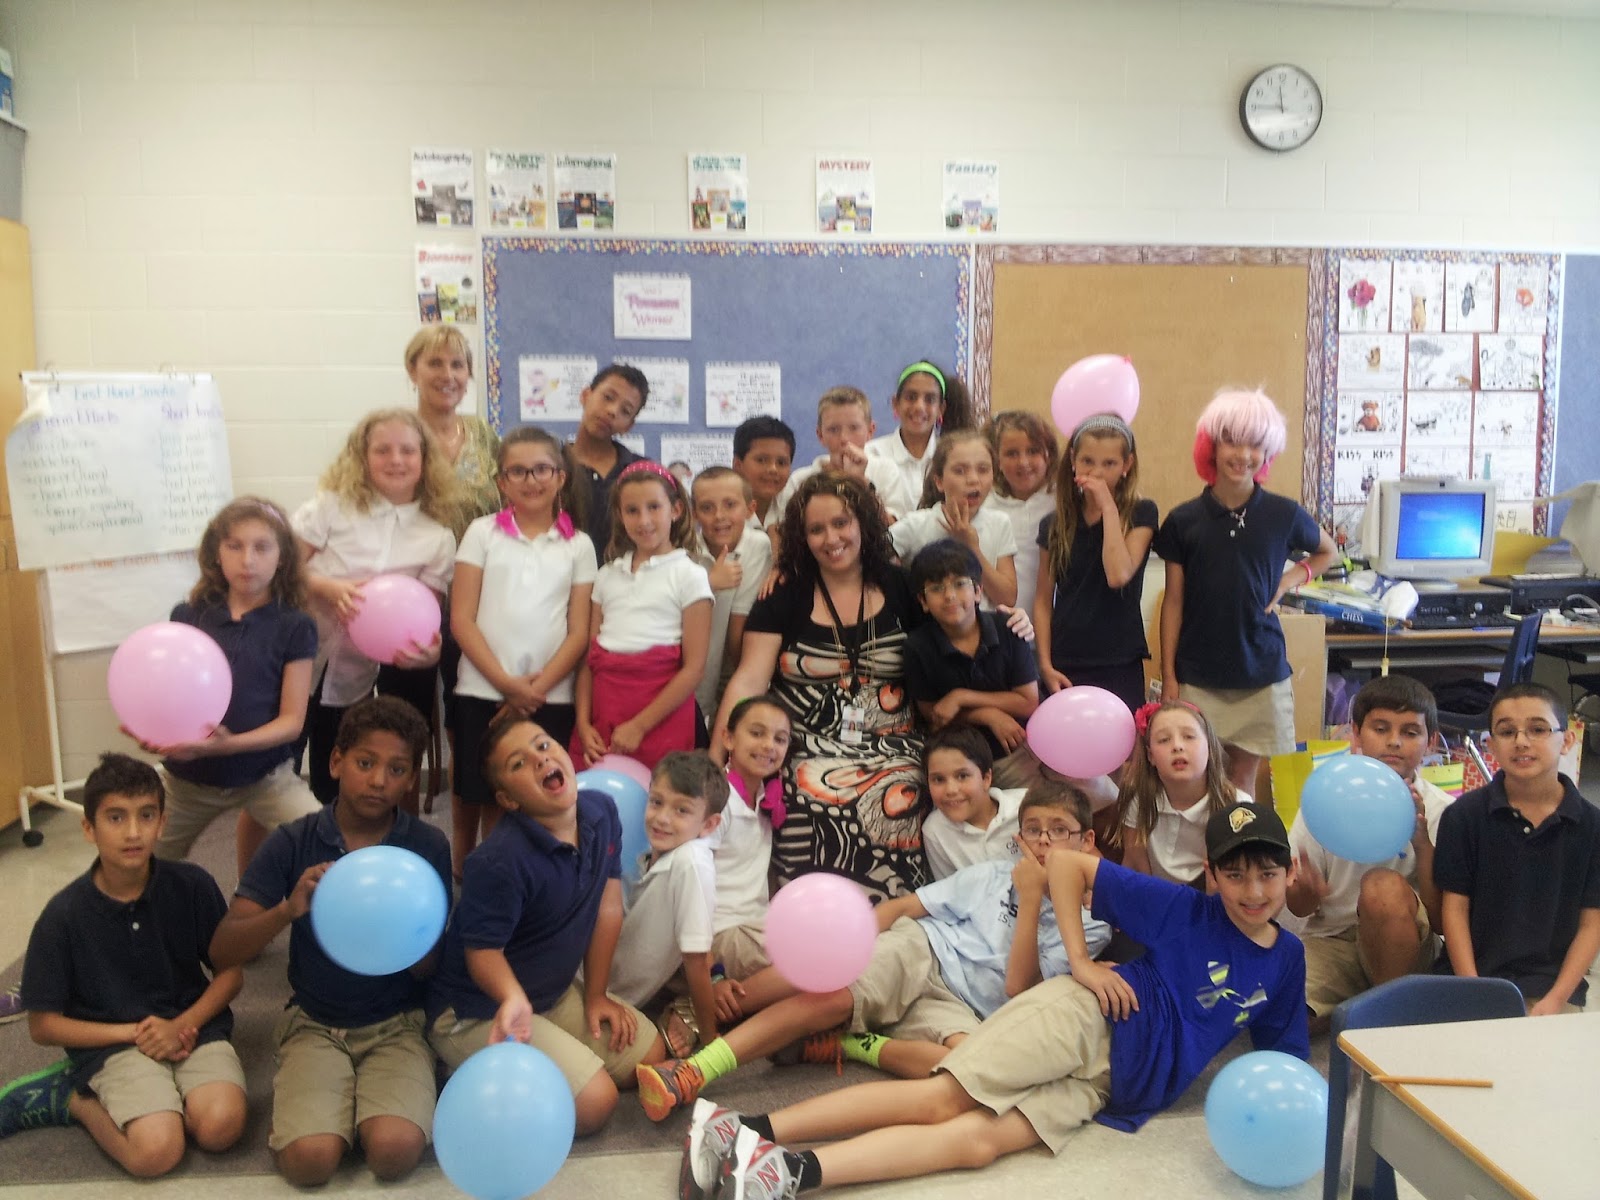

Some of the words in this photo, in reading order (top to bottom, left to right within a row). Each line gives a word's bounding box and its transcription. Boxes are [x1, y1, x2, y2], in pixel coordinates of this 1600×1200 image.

[413, 151, 472, 166] Autobiography
[556, 155, 613, 170] Informational
[819, 160, 871, 171] MYSTERY
[946, 163, 998, 176] Fantasy
[1341, 612, 1364, 624] CHESS
